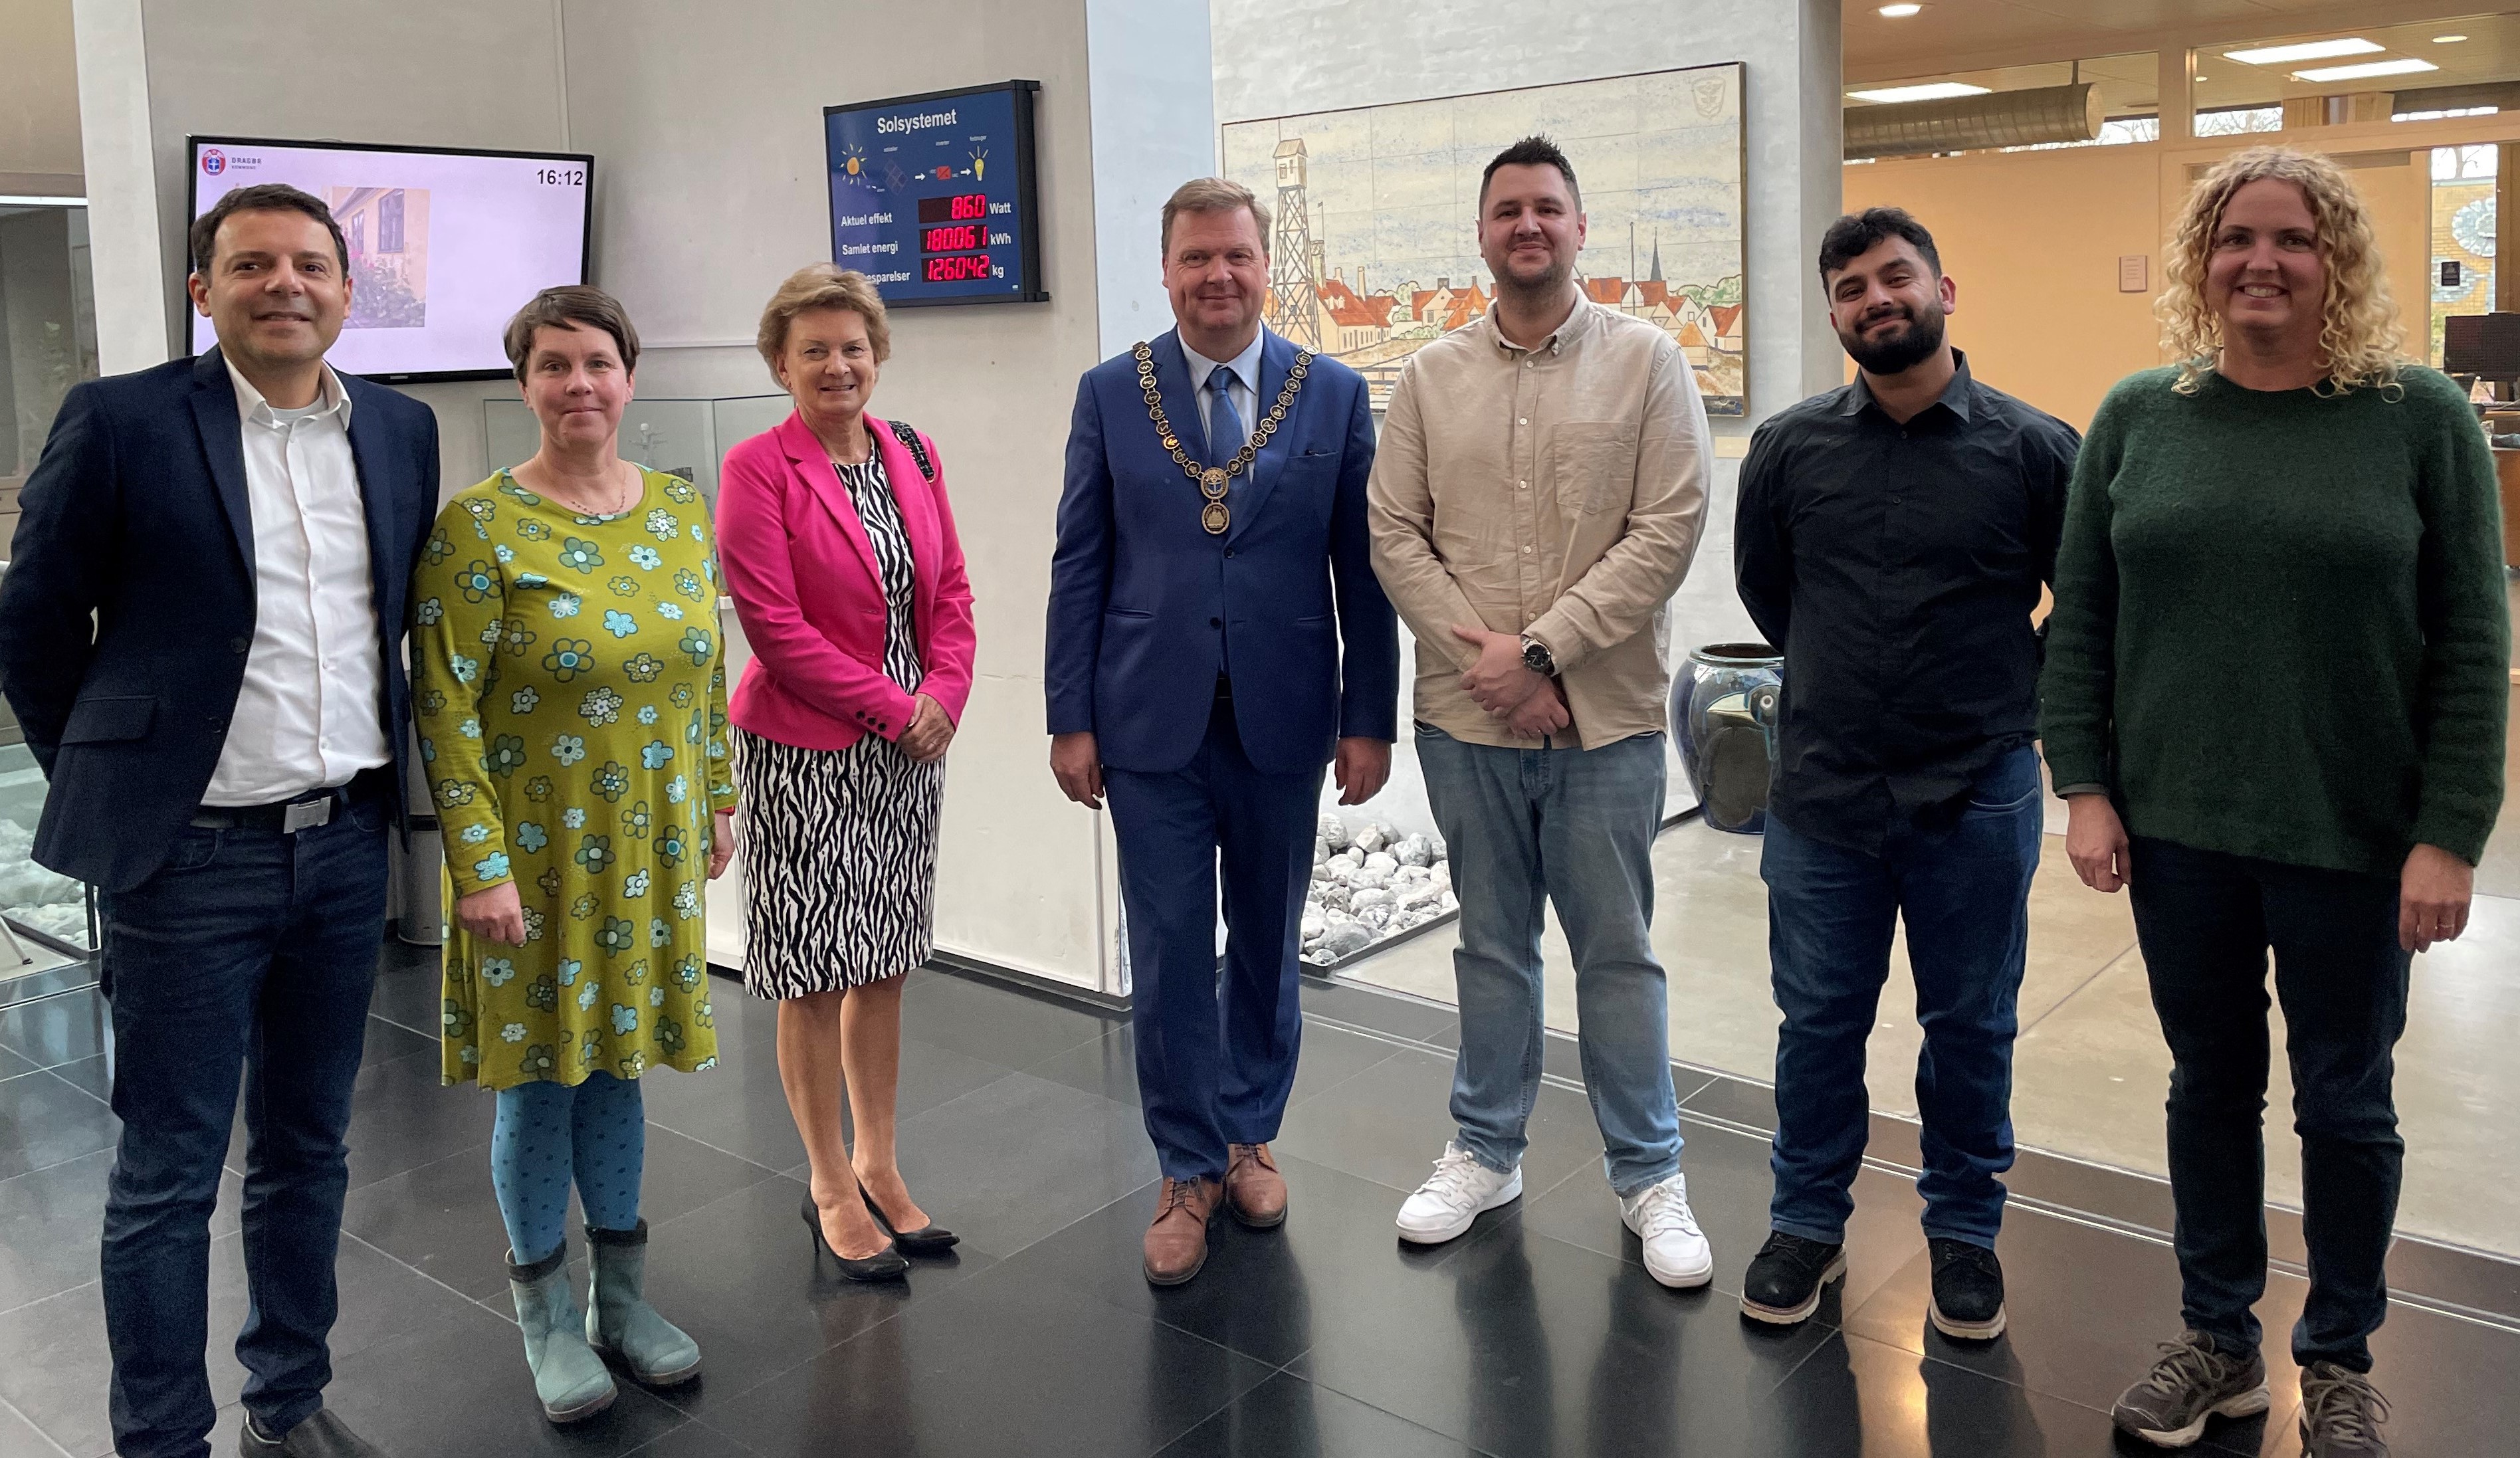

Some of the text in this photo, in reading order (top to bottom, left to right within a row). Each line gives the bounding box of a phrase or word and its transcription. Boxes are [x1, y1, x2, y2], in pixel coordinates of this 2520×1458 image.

[877, 108, 957, 134] Solsystemet
[536, 169, 584, 187] 16:12
[841, 194, 1011, 227] Aktuel effekt 860 Watt
[842, 225, 1011, 256] Samlet energi 180061 kWh
[928, 255, 990, 280] 126042
[992, 264, 1004, 278] kg
